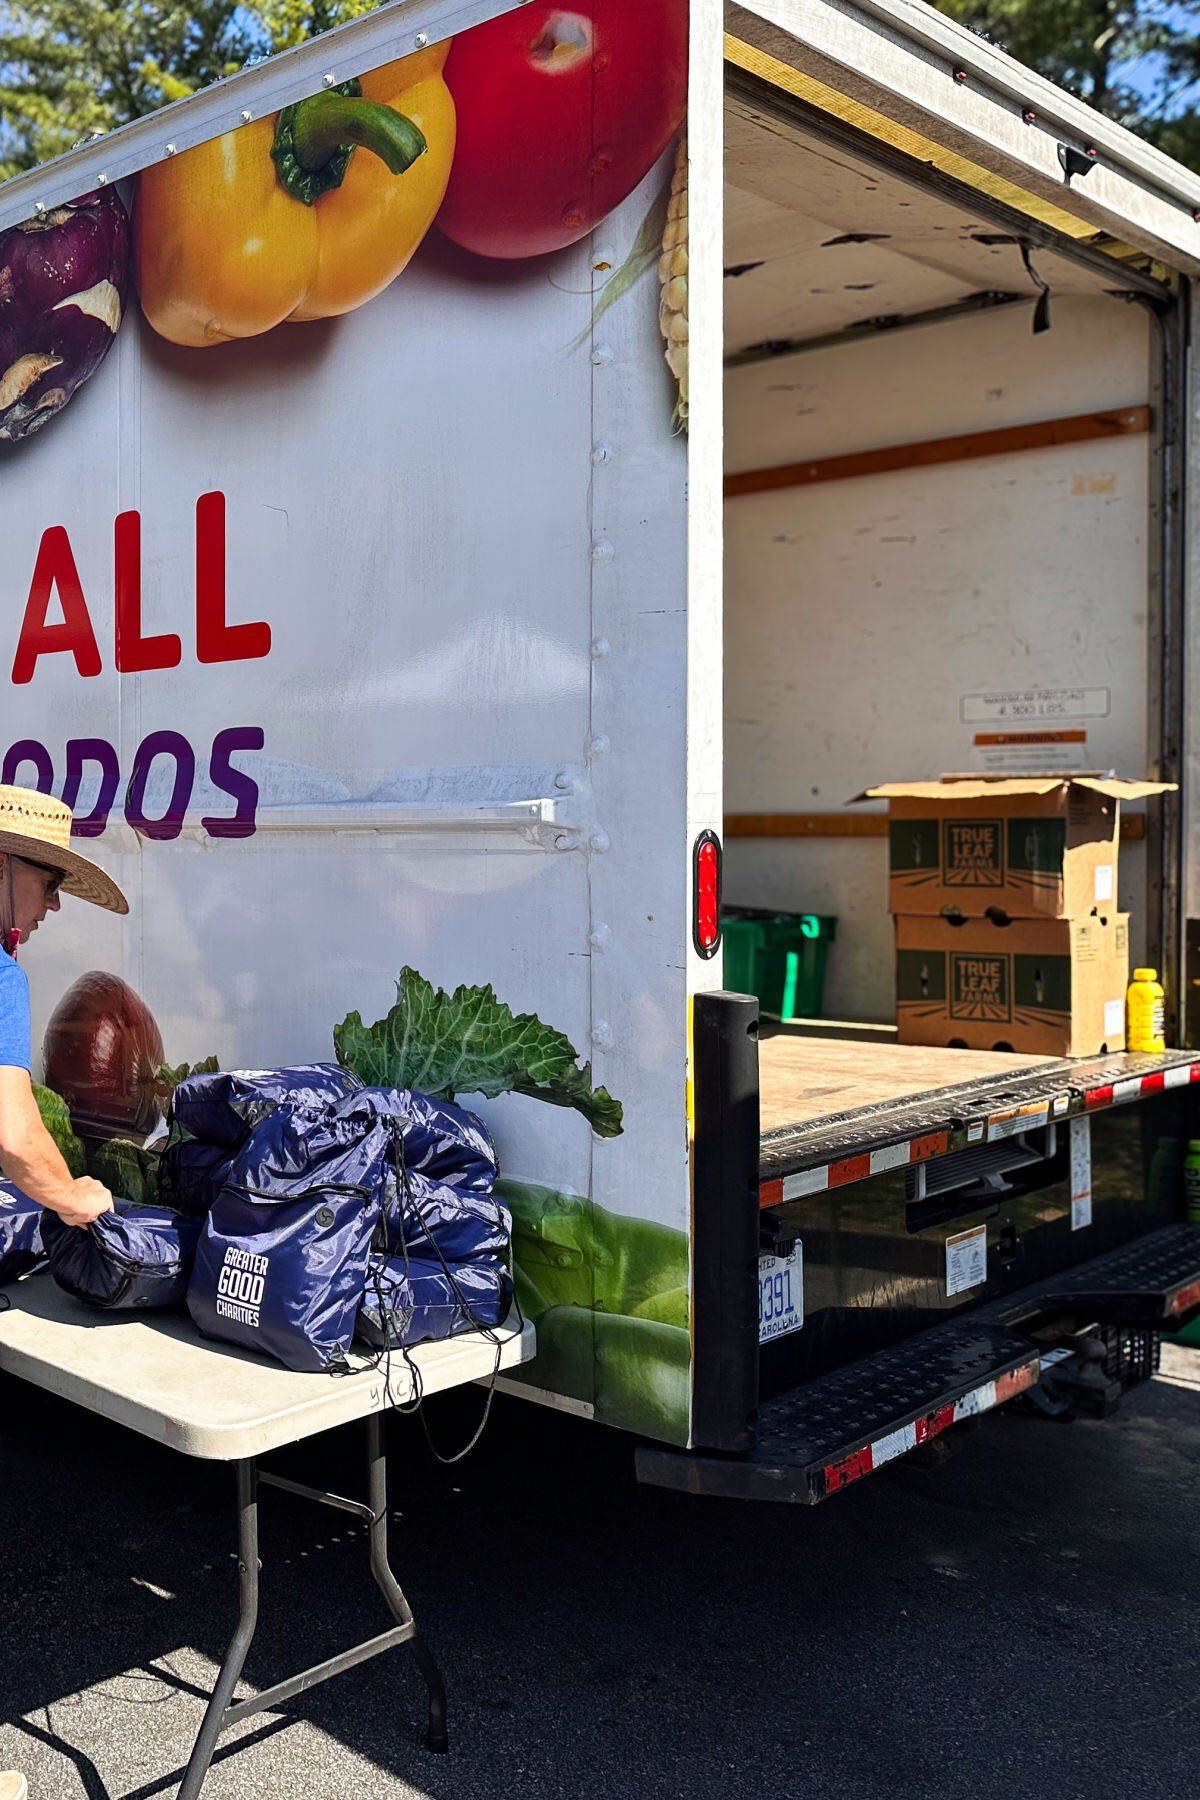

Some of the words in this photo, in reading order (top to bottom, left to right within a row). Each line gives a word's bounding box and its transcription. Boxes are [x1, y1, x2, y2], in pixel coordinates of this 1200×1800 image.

[11, 490, 272, 685] ALL
[951, 827, 994, 843] TRUE
[953, 843, 994, 858] LEAF
[958, 960, 1001, 977] TRUE
[959, 976, 1001, 992] LEAF
[223, 1246, 269, 1276] GREATER
[217, 1265, 266, 1305] GOOD
[216, 1299, 260, 1328] CHARITIES
[759, 1314, 799, 1339] AROLINA
